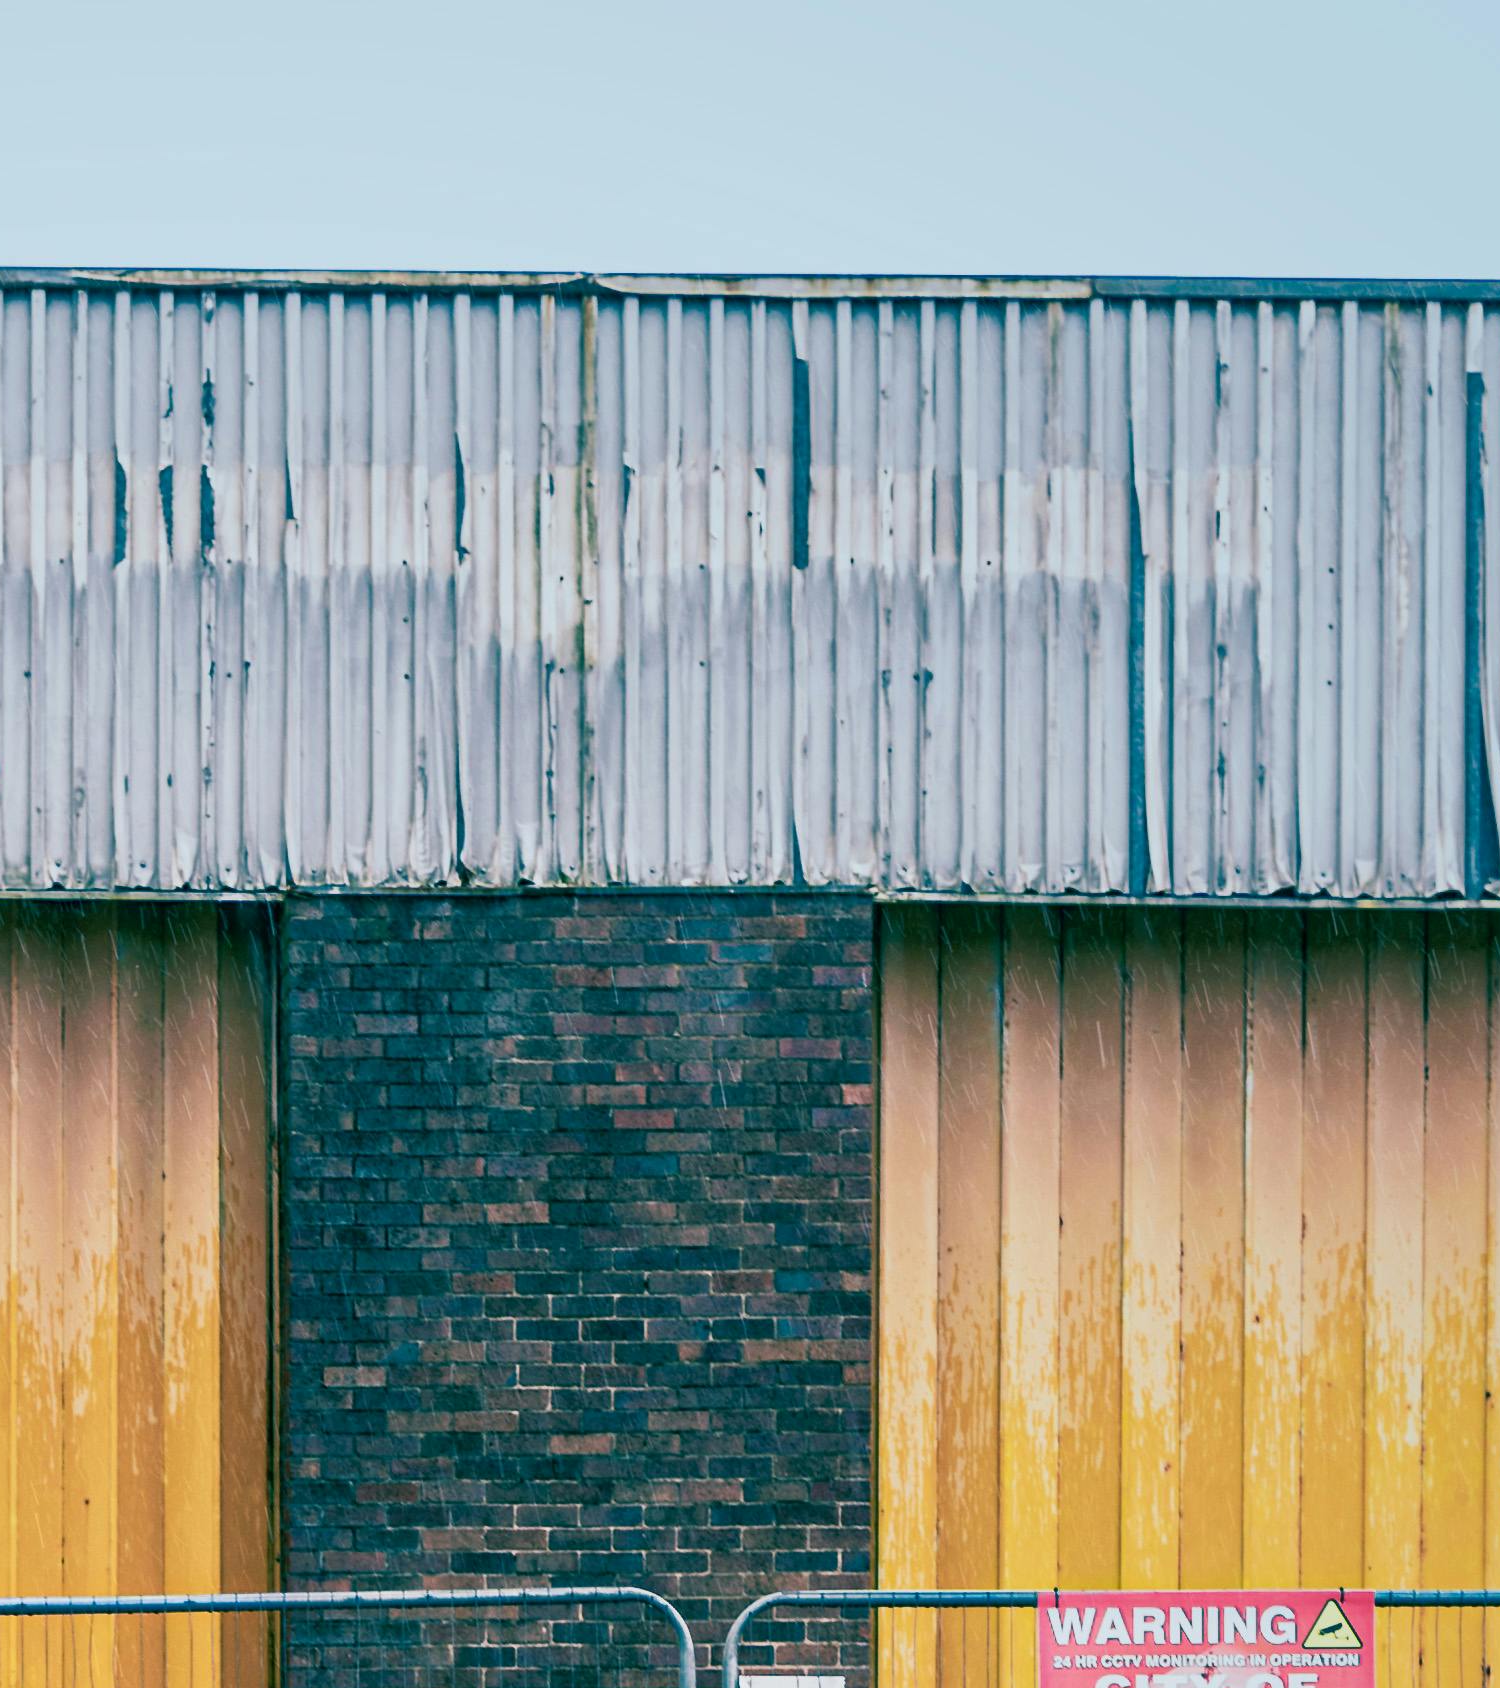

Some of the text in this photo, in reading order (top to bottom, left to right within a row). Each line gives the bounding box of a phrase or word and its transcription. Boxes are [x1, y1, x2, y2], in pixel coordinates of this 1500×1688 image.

[1047, 1605, 1297, 1646] WARNING
[1052, 1653, 1361, 1669] 24 HR CCTV MONITORING IN OPERATION
